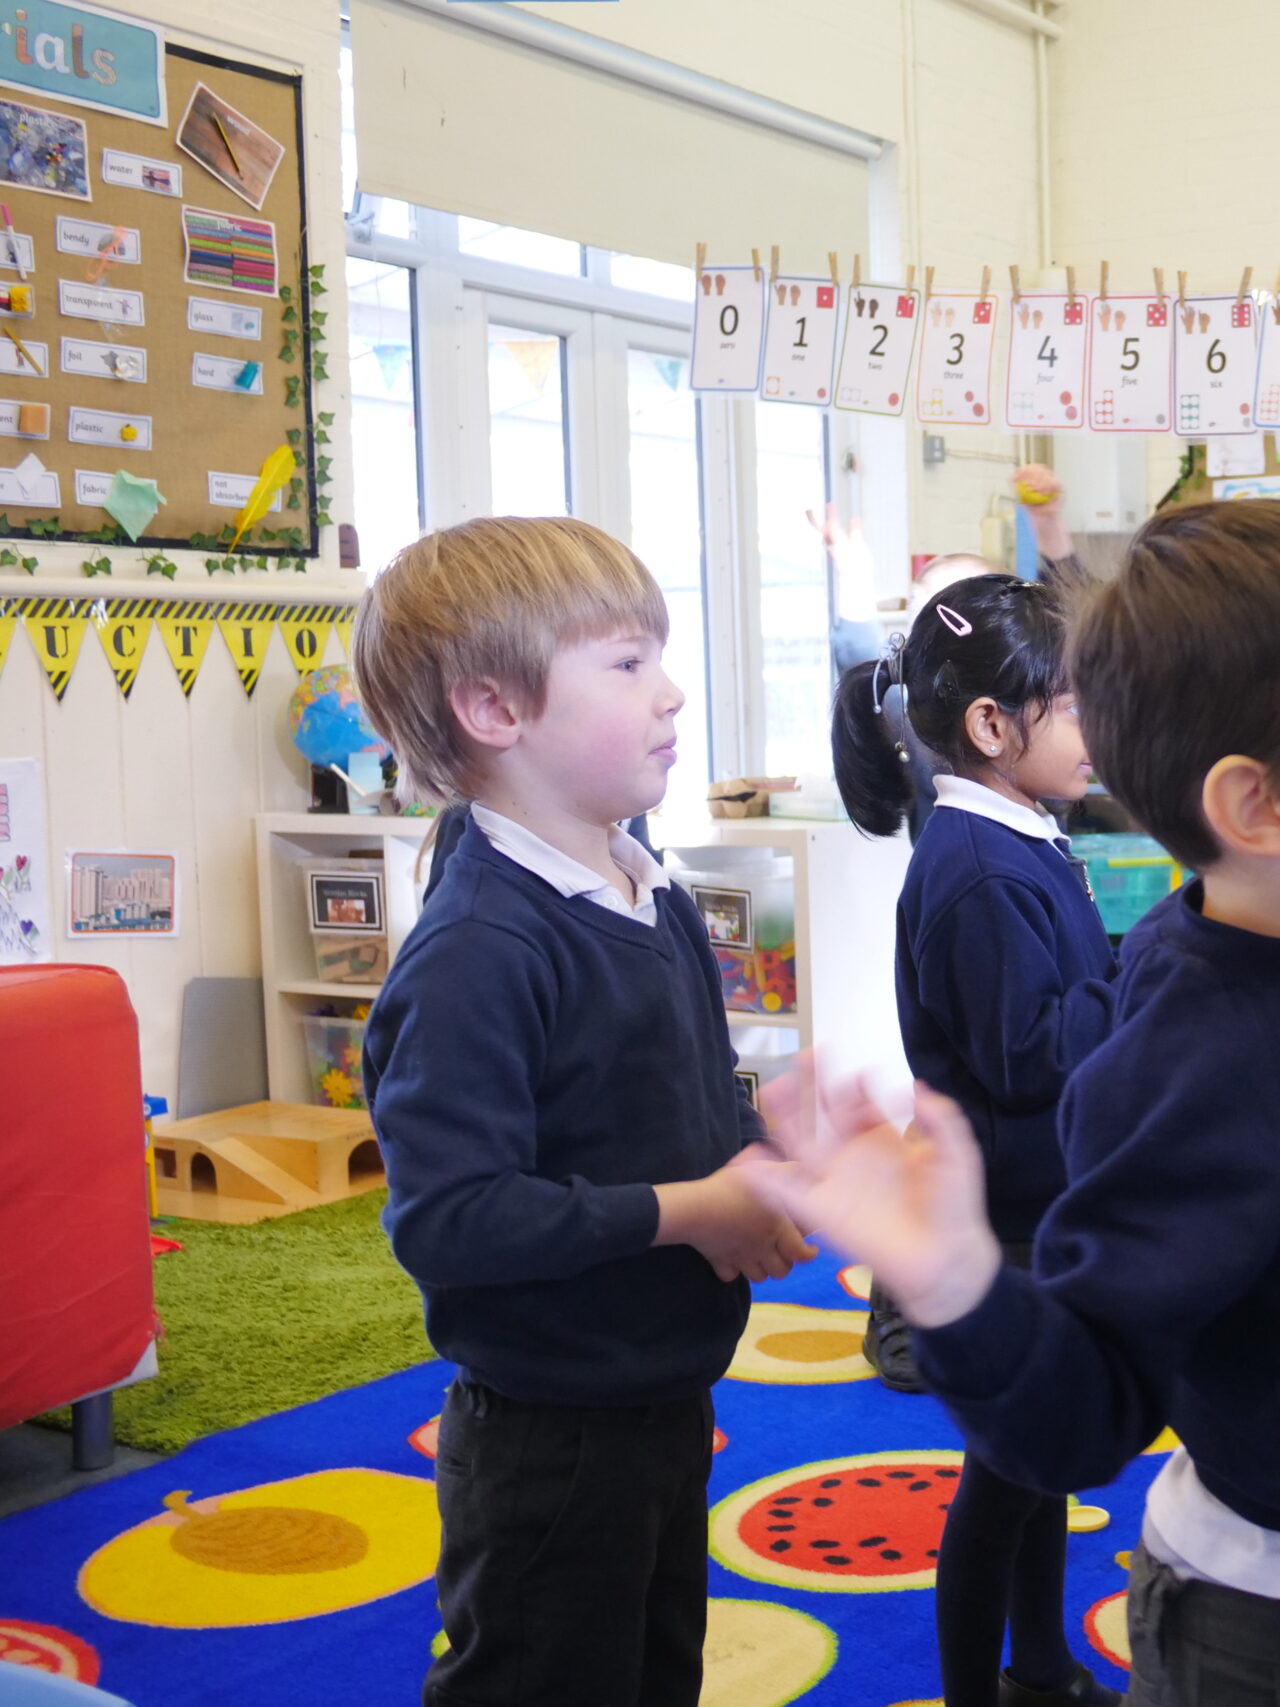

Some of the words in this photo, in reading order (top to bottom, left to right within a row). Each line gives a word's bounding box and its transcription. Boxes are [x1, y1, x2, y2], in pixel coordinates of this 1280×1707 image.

[108, 164, 133, 175] water
[63, 232, 90, 247] bendy
[193, 311, 214, 323] glass
[719, 305, 739, 336] 0
[793, 317, 808, 347] 1
[868, 325, 888, 357] 2
[67, 350, 82, 362] foil
[946, 333, 965, 365] 3
[1037, 335, 1058, 368] 4
[1120, 338, 1140, 371] 5
[1206, 339, 1227, 374] 6
[197, 366, 215, 378] hard
[1121, 376, 1138, 387] five
[1210, 380, 1223, 389] six
[75, 421, 104, 434] plastic
[82, 484, 107, 496] fabric
